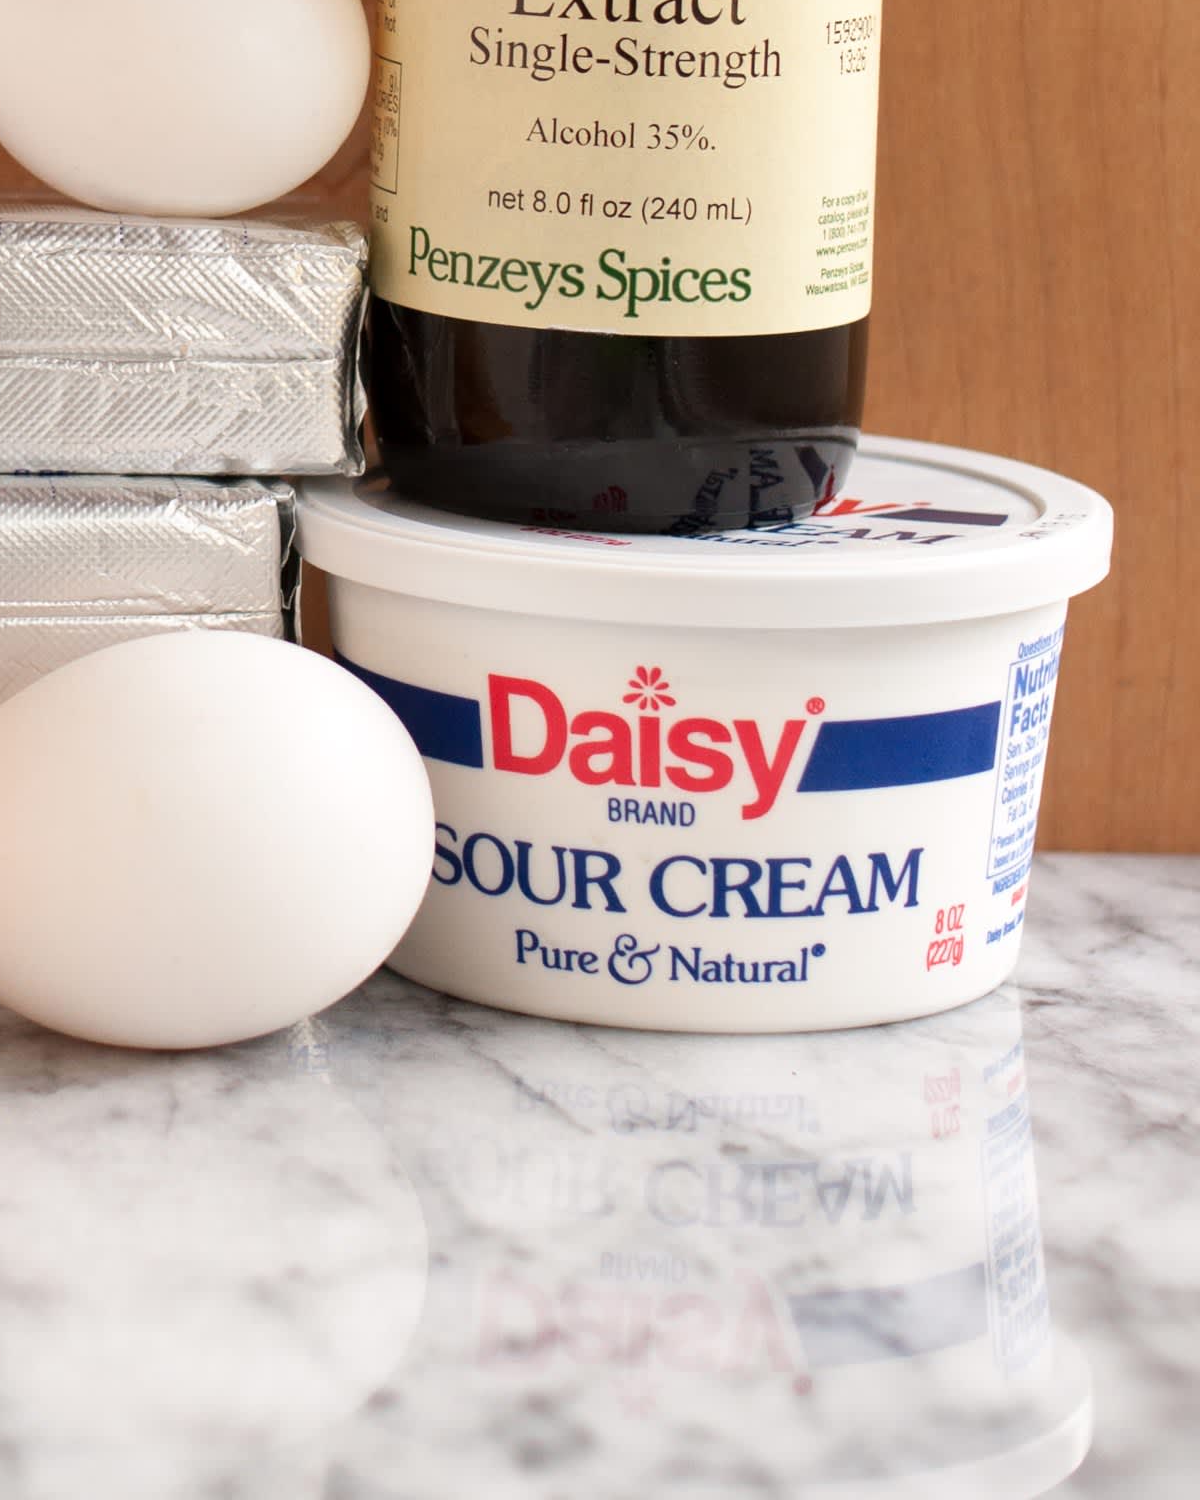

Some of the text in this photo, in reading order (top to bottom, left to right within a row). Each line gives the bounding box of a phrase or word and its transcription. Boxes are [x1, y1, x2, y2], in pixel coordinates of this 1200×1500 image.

[469, 26, 782, 89] Single-Strength
[526, 117, 717, 151] Alcohol 35%.
[488, 189, 753, 226] net 8.0 fl oz (240 mL)
[408, 225, 753, 318] Penzeys Spices
[1009, 693, 1050, 738] Facts
[488, 666, 808, 821] Daisy
[607, 797, 696, 828] BRAND
[431, 821, 926, 919] SOUR CREAM
[934, 903, 965, 935] 8 OZ
[515, 928, 809, 986] Pure & Natural
[926, 931, 964, 973] (227g)
